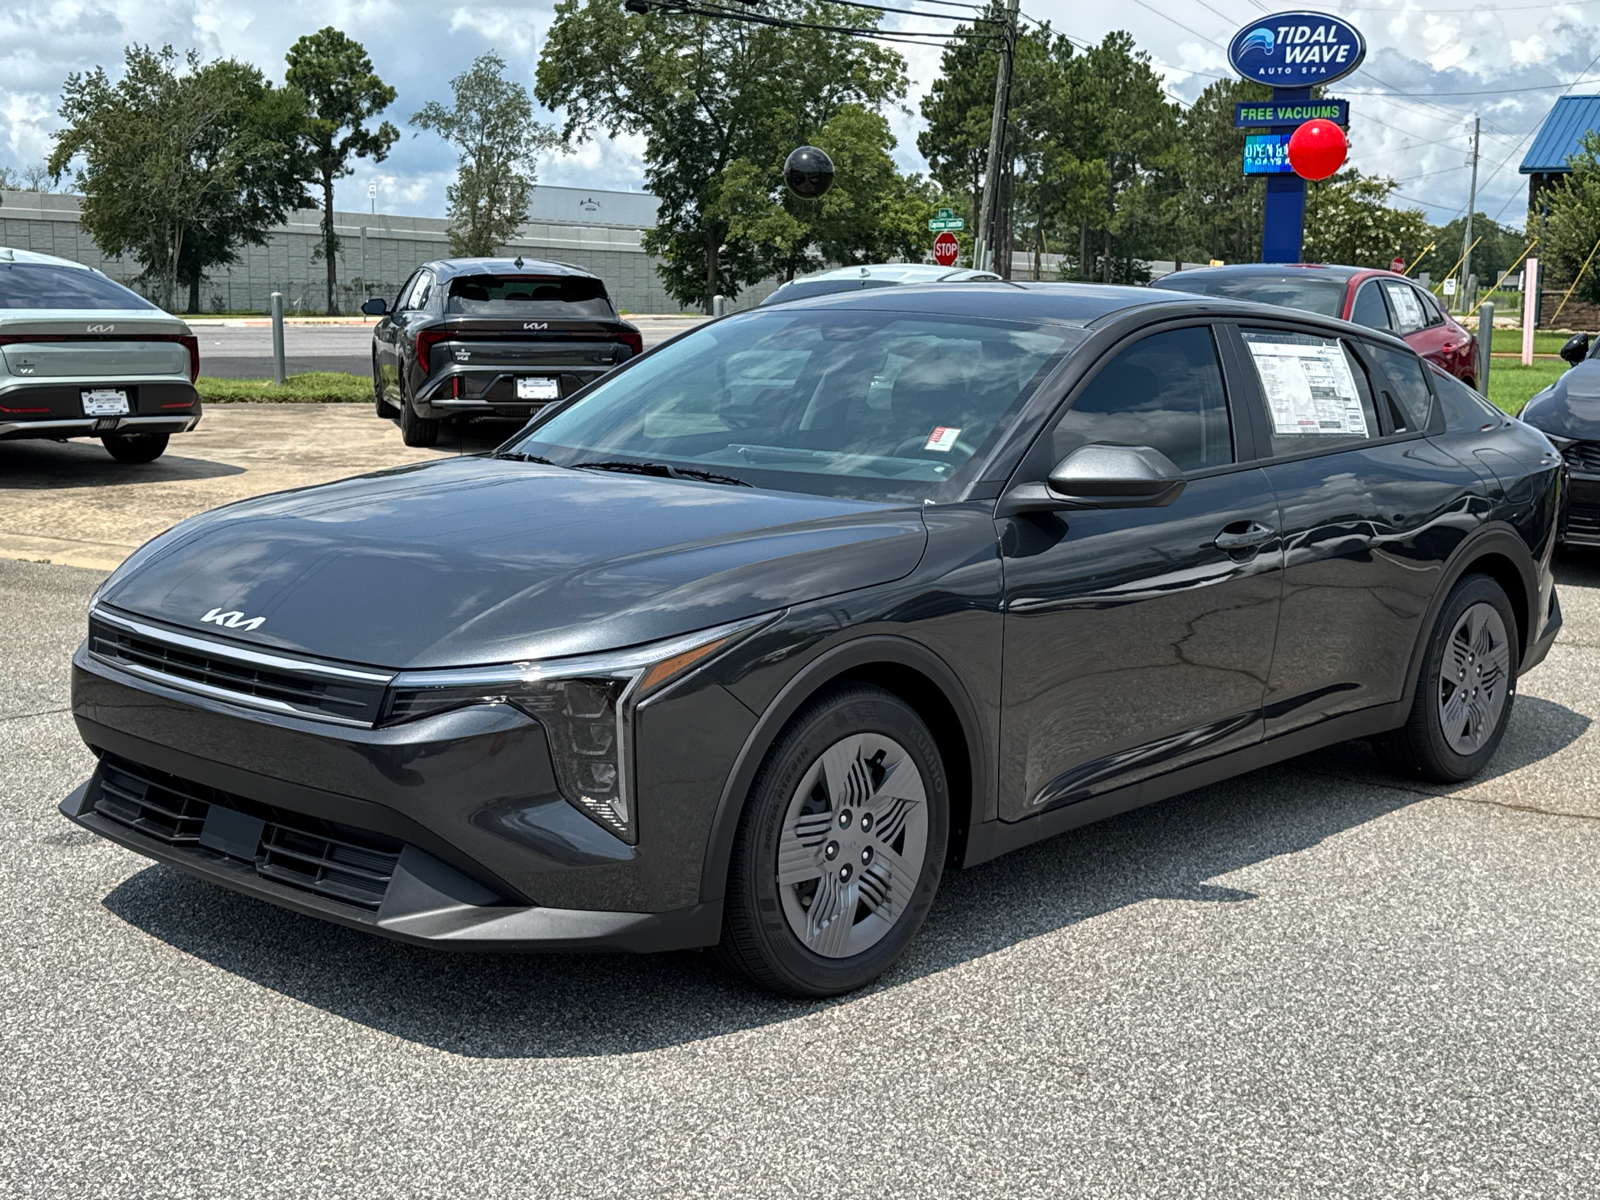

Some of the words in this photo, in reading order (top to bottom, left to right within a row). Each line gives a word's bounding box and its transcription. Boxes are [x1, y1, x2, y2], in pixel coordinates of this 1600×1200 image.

[1276, 25, 1338, 44] TIDAL
[1285, 45, 1350, 63] WAVE
[1258, 67, 1292, 75] AUTO
[1301, 66, 1326, 74] SPA
[1240, 107, 1274, 121] FREE
[1277, 105, 1340, 119] VACUUMS
[936, 243, 957, 256] STOP
[86, 324, 115, 333] KIA
[523, 322, 548, 330] KIA
[200, 607, 266, 632] KIA
[909, 725, 943, 793] KUMHO
